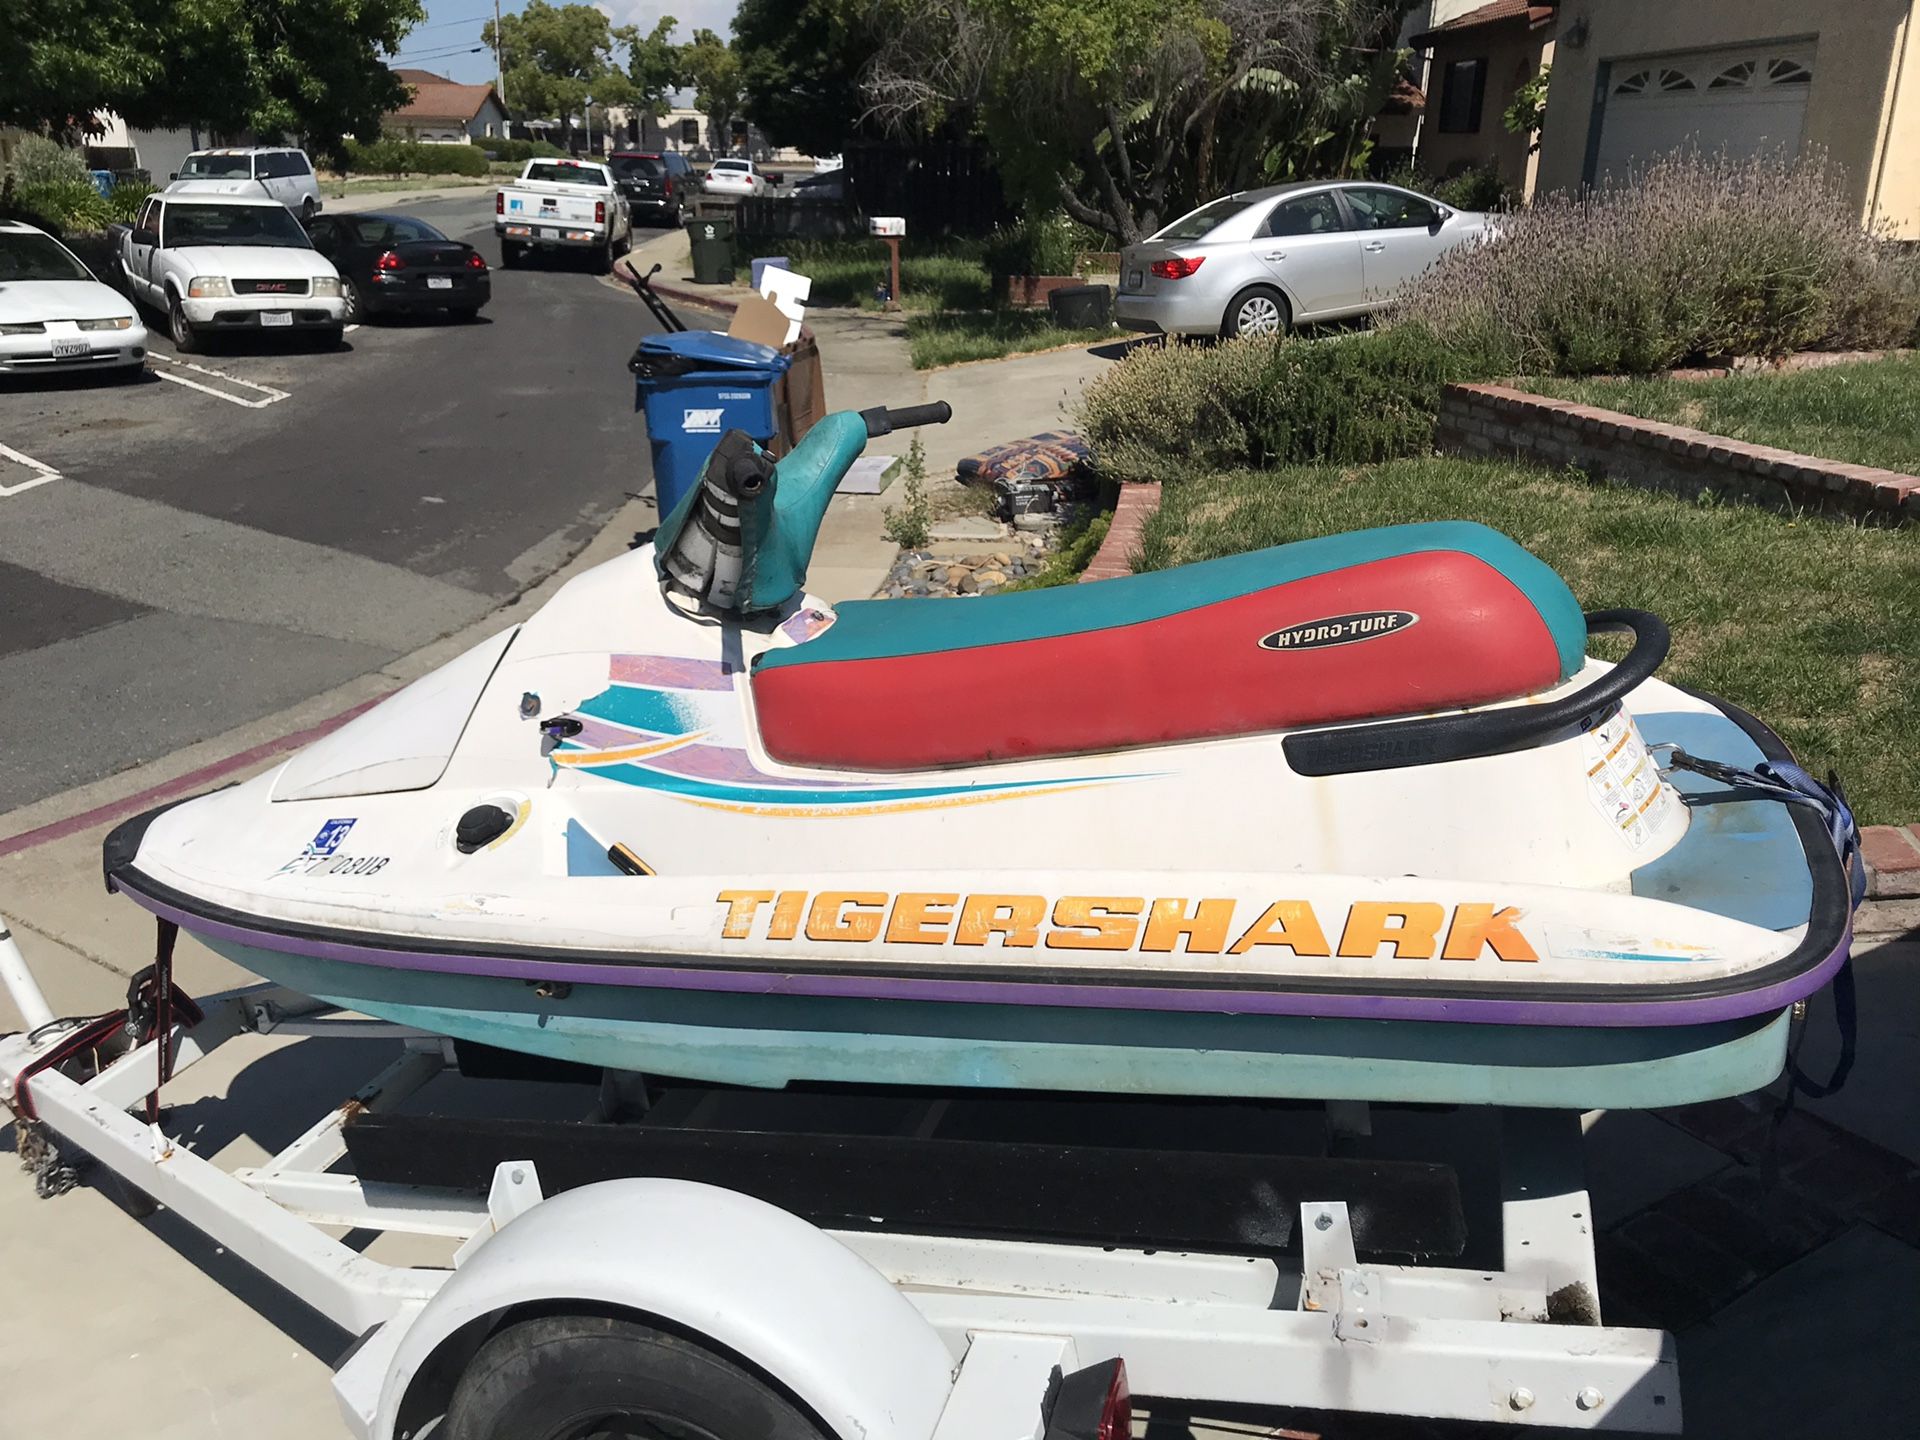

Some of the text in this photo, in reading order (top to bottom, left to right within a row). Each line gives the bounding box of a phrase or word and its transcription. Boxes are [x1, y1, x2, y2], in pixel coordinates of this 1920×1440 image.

[256, 283, 287, 292] GMC
[1278, 614, 1398, 647] HYDRO-TURF
[325, 825, 350, 848] 13
[716, 890, 1540, 962] TIGERSHARK
